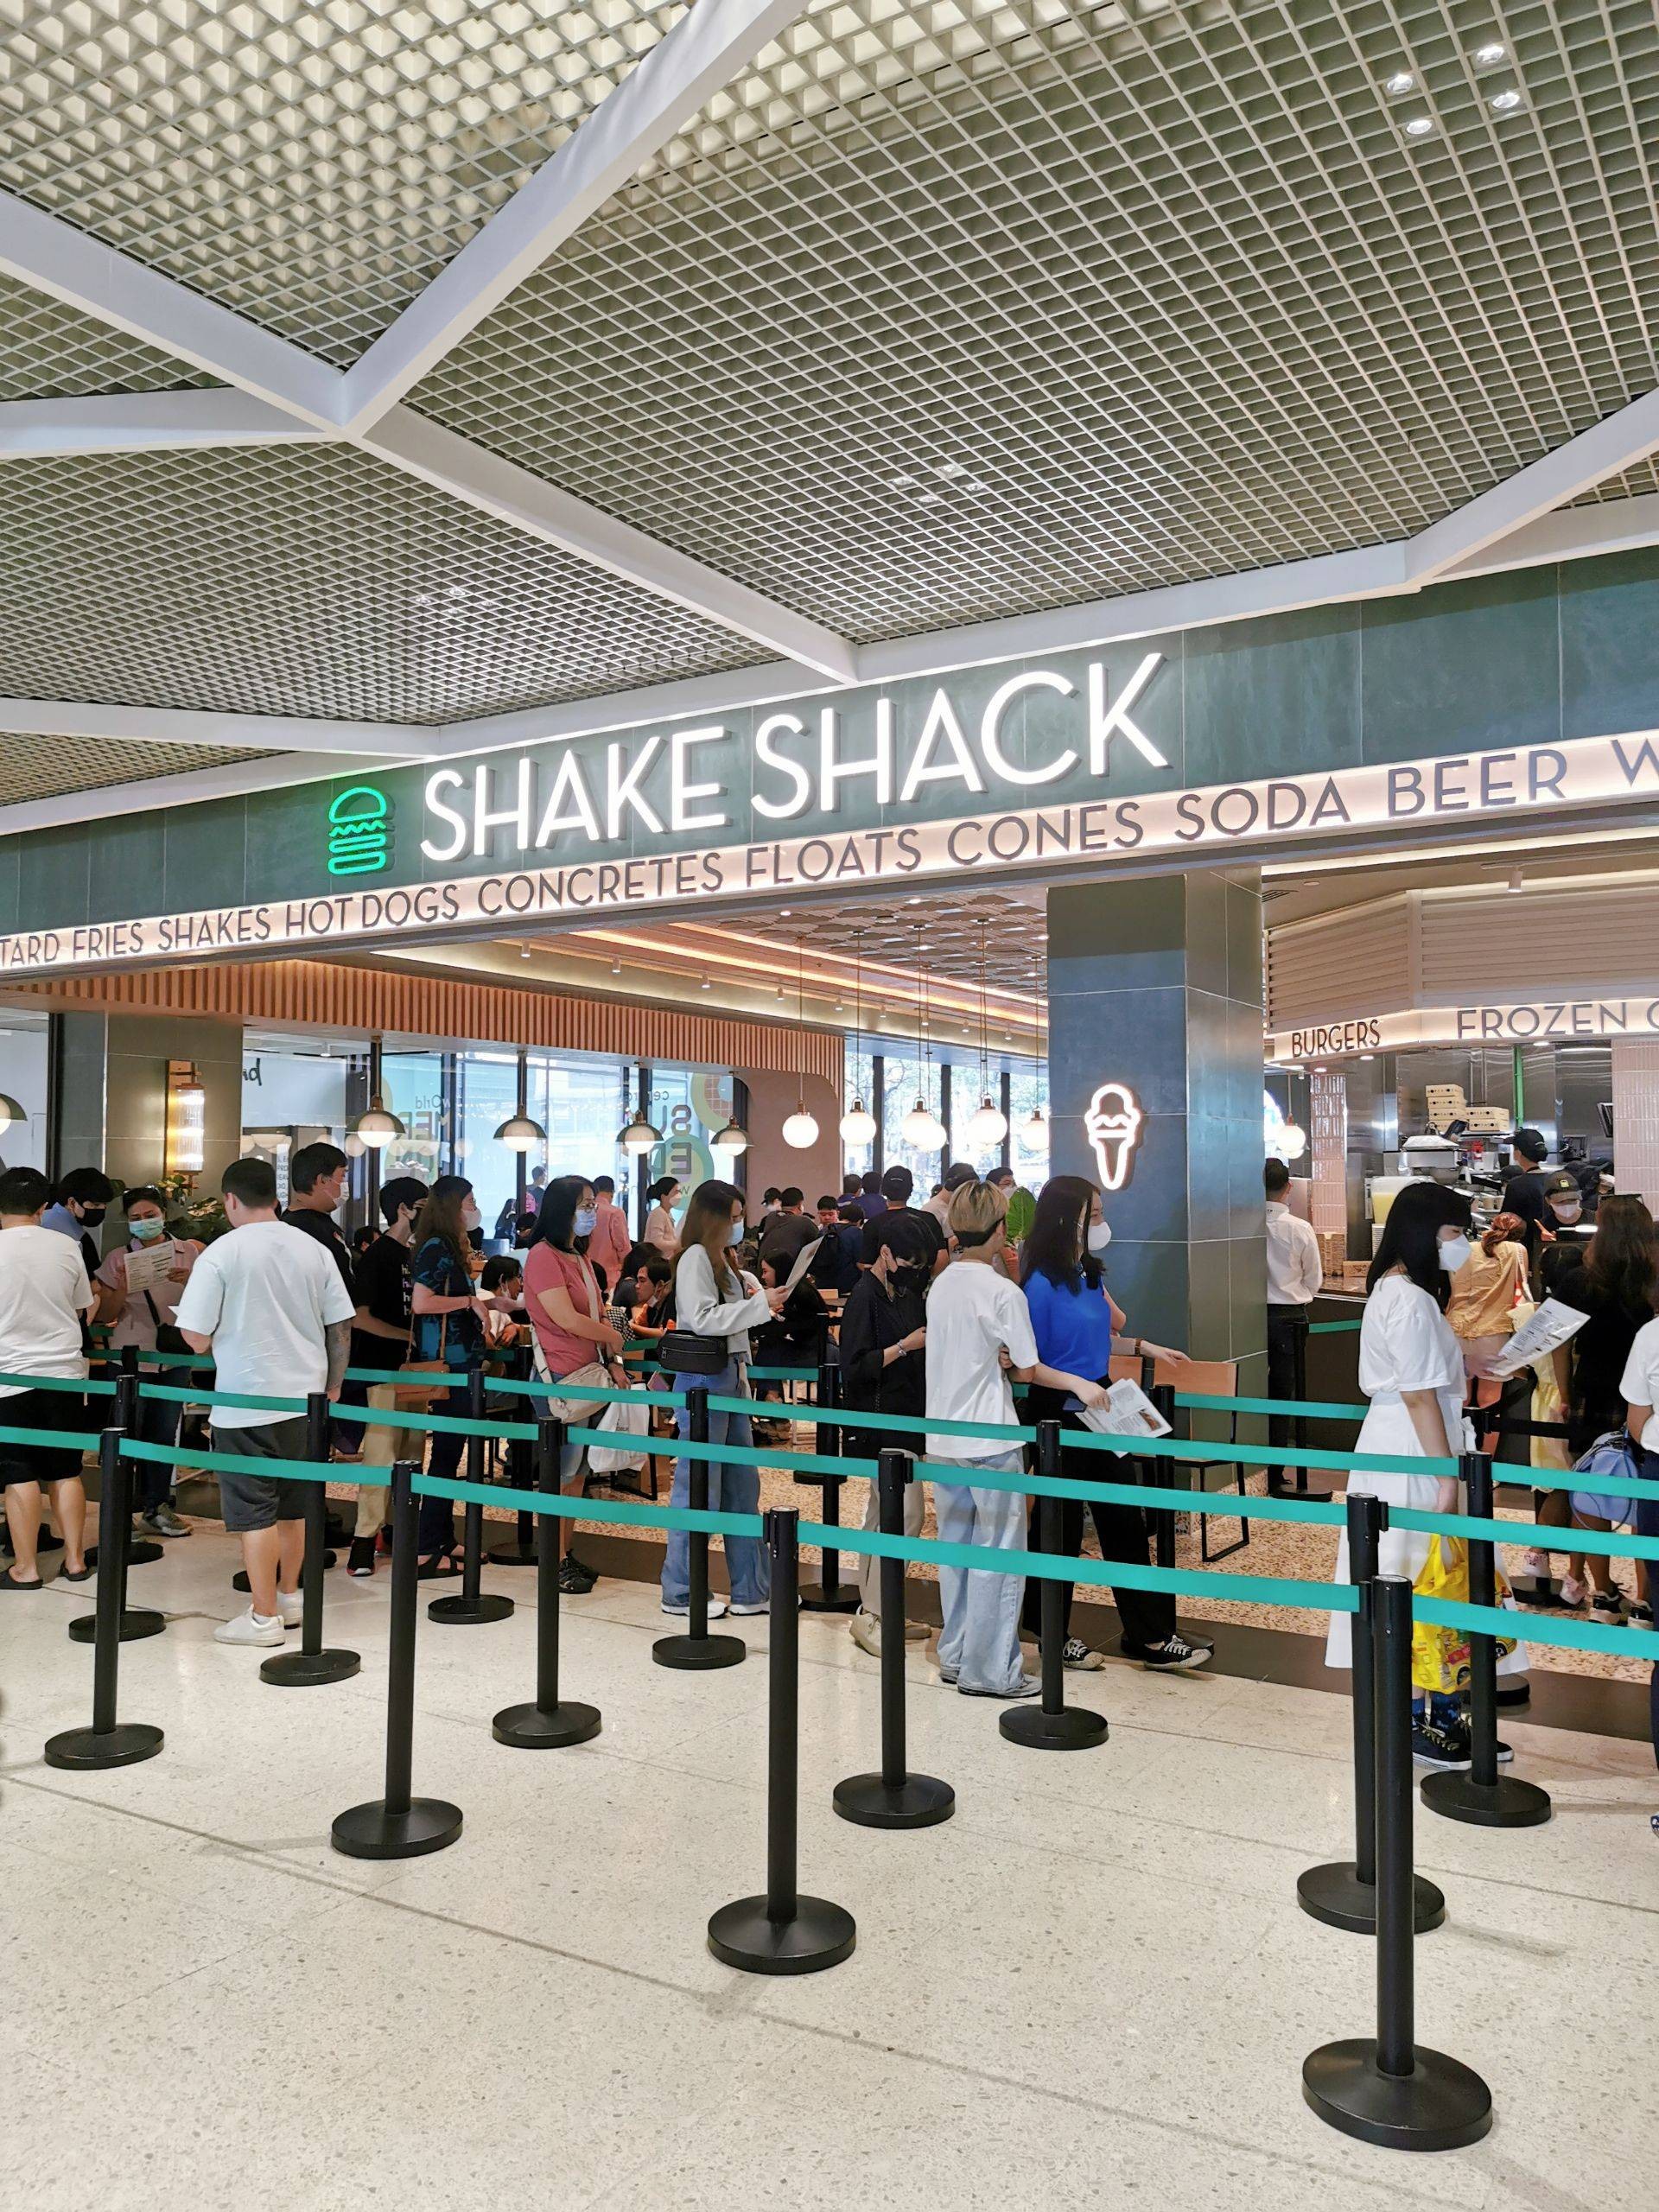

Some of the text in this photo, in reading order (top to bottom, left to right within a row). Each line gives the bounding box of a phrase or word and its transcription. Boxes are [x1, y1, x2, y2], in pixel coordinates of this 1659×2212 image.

[73, 921, 144, 961] FRIES
[157, 906, 272, 951] SHAKES
[477, 851, 724, 917] CONCRETES
[746, 827, 922, 888] FLOATS
[947, 801, 1145, 866] CONES
[1174, 774, 1352, 842] SODA
[1386, 748, 1568, 819] BEER
[420, 652, 1170, 862] SHAKE SHACK
[1291, 1018, 1381, 1059] BURGERS
[1456, 1001, 1627, 1039] FROZEN
